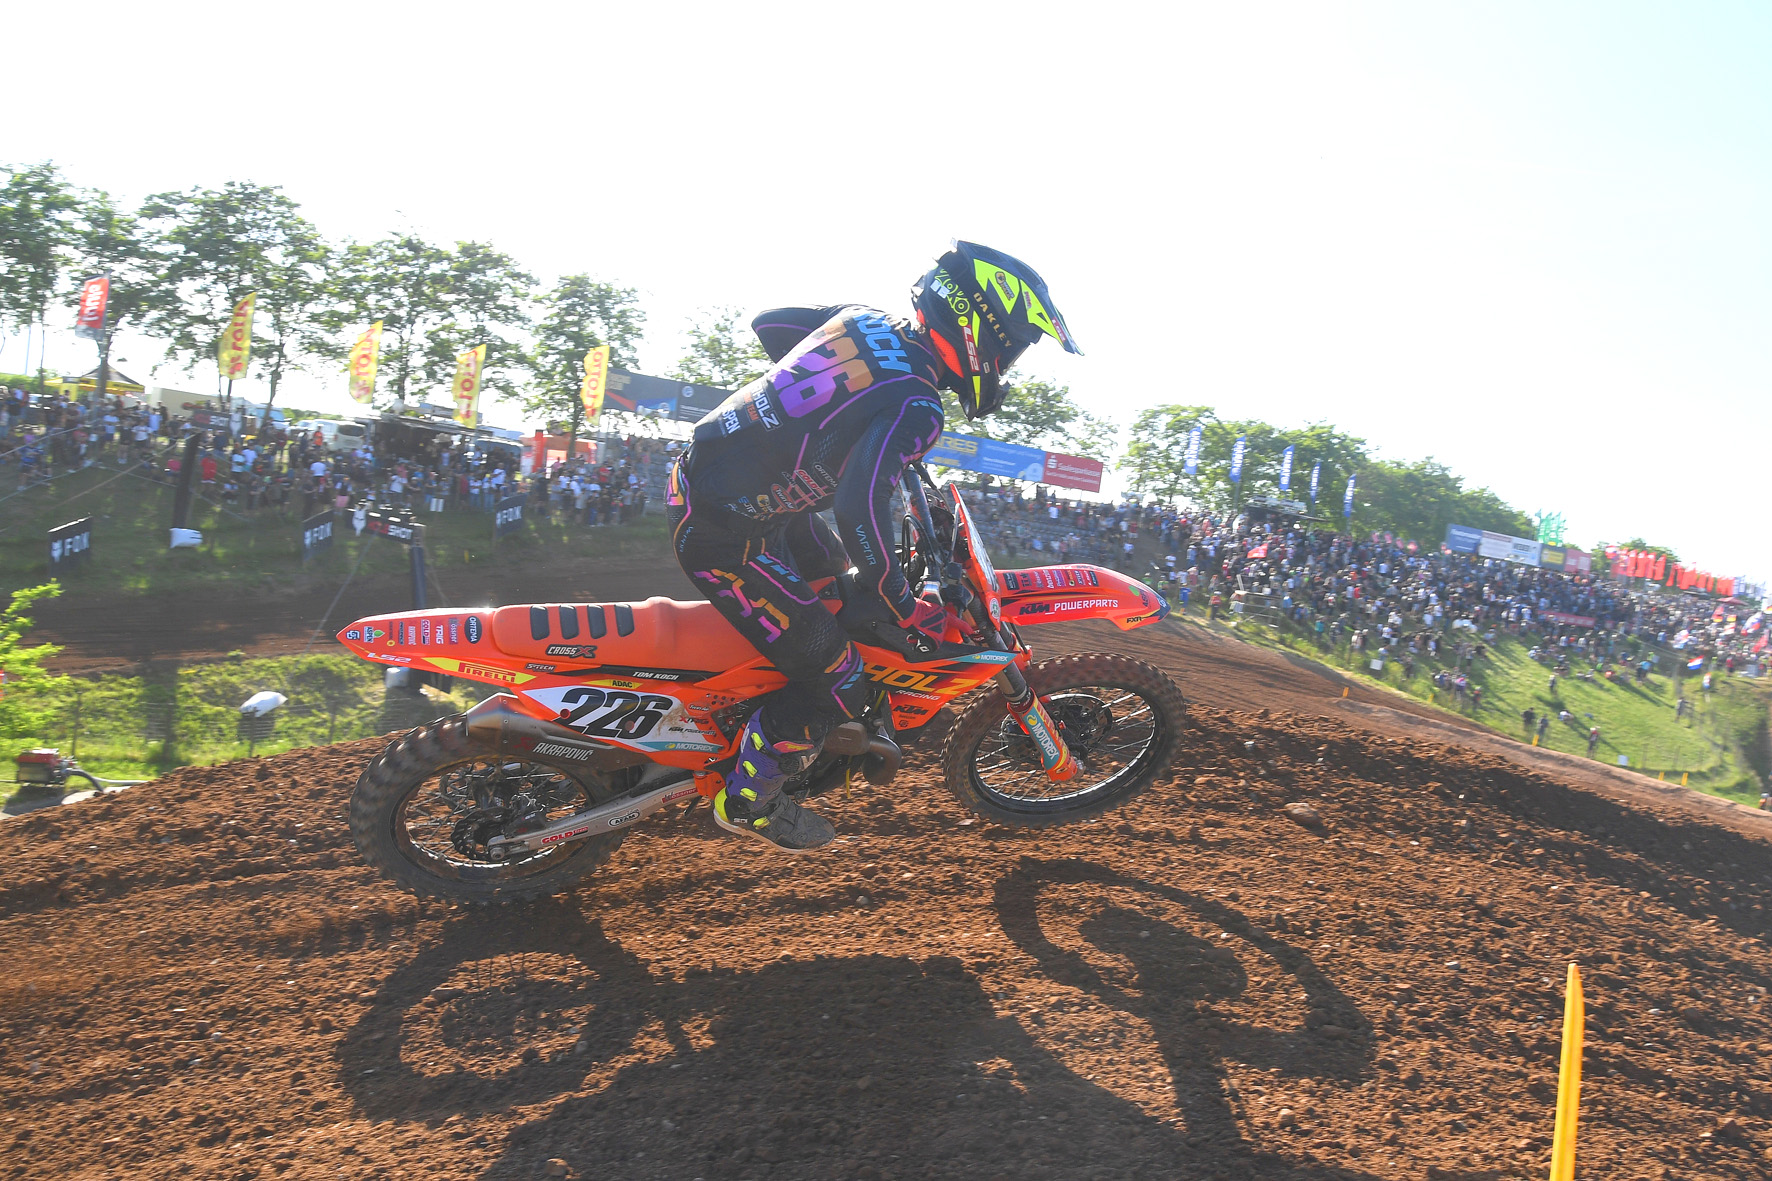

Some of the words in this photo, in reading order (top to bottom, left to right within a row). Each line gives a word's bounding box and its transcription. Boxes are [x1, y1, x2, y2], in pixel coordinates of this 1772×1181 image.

[973, 292, 1012, 347] OAKLEY
[963, 326, 980, 371] LS2
[814, 464, 838, 487] ORTEMA
[855, 524, 877, 567] VAPOR
[469, 617, 477, 643] ORTEMA
[980, 654, 1009, 662] MOTOREX
[457, 662, 516, 684] PIRELLI
[653, 673, 680, 681] KOCH
[612, 680, 633, 689] ADAC
[896, 690, 941, 701] RACING
[551, 687, 674, 740] 226
[893, 704, 929, 715] KTM
[676, 743, 715, 752] MOTOREX
[1032, 723, 1059, 760] MOTOREX
